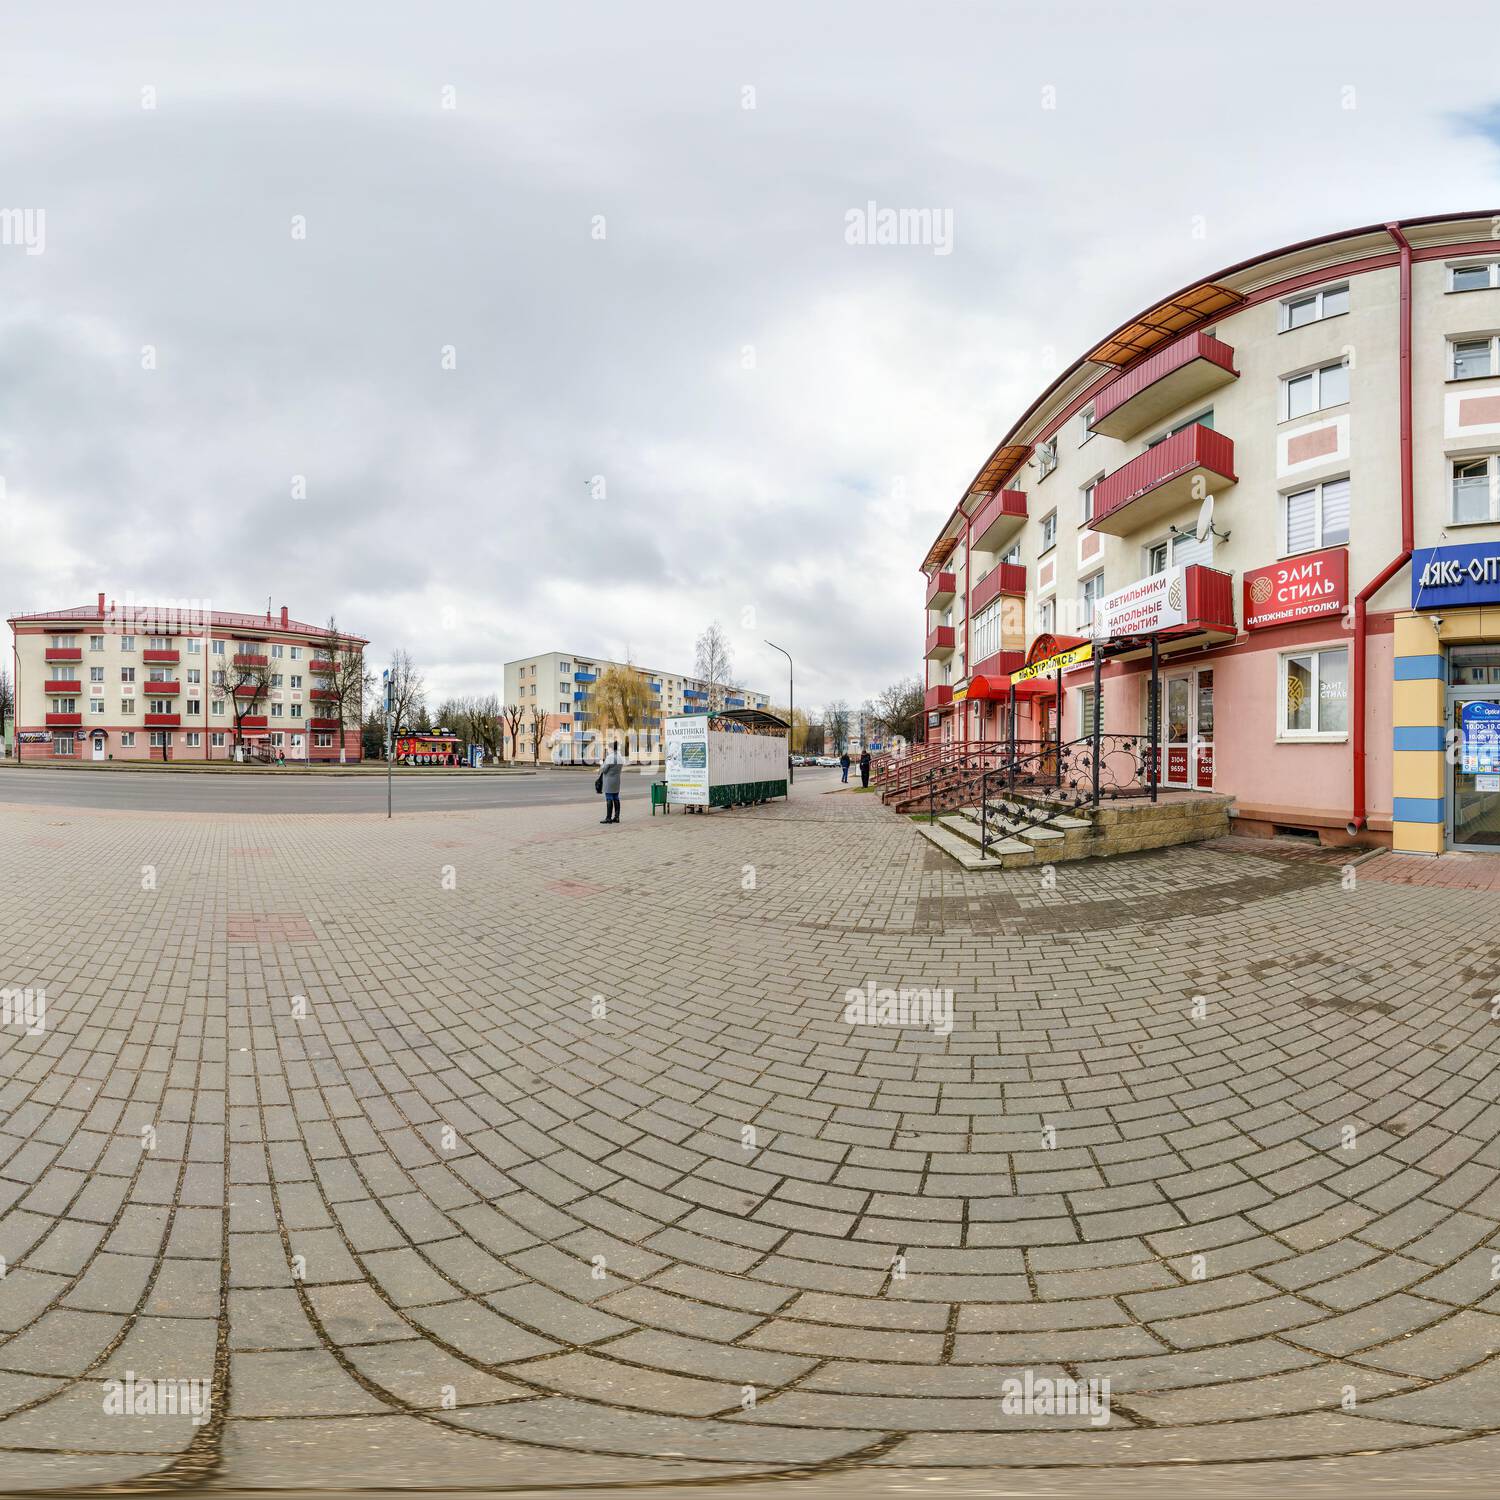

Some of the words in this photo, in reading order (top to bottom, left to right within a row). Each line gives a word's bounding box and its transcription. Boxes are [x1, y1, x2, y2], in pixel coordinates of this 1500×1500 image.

[1277, 561, 1323, 584] ЭЛИТ
[1104, 578, 1167, 611] СВЕТИЛЬНИКИ
[1277, 579, 1335, 602] СТИЛЬ
[1108, 600, 1162, 628] НАПОЛЬНЫЕ
[1247, 609, 1294, 625] НАТЯЖНЫЕ
[1295, 601, 1340, 616] ПОТОЛКИ
[1110, 615, 1158, 637] ПОКРЫТИЯ
